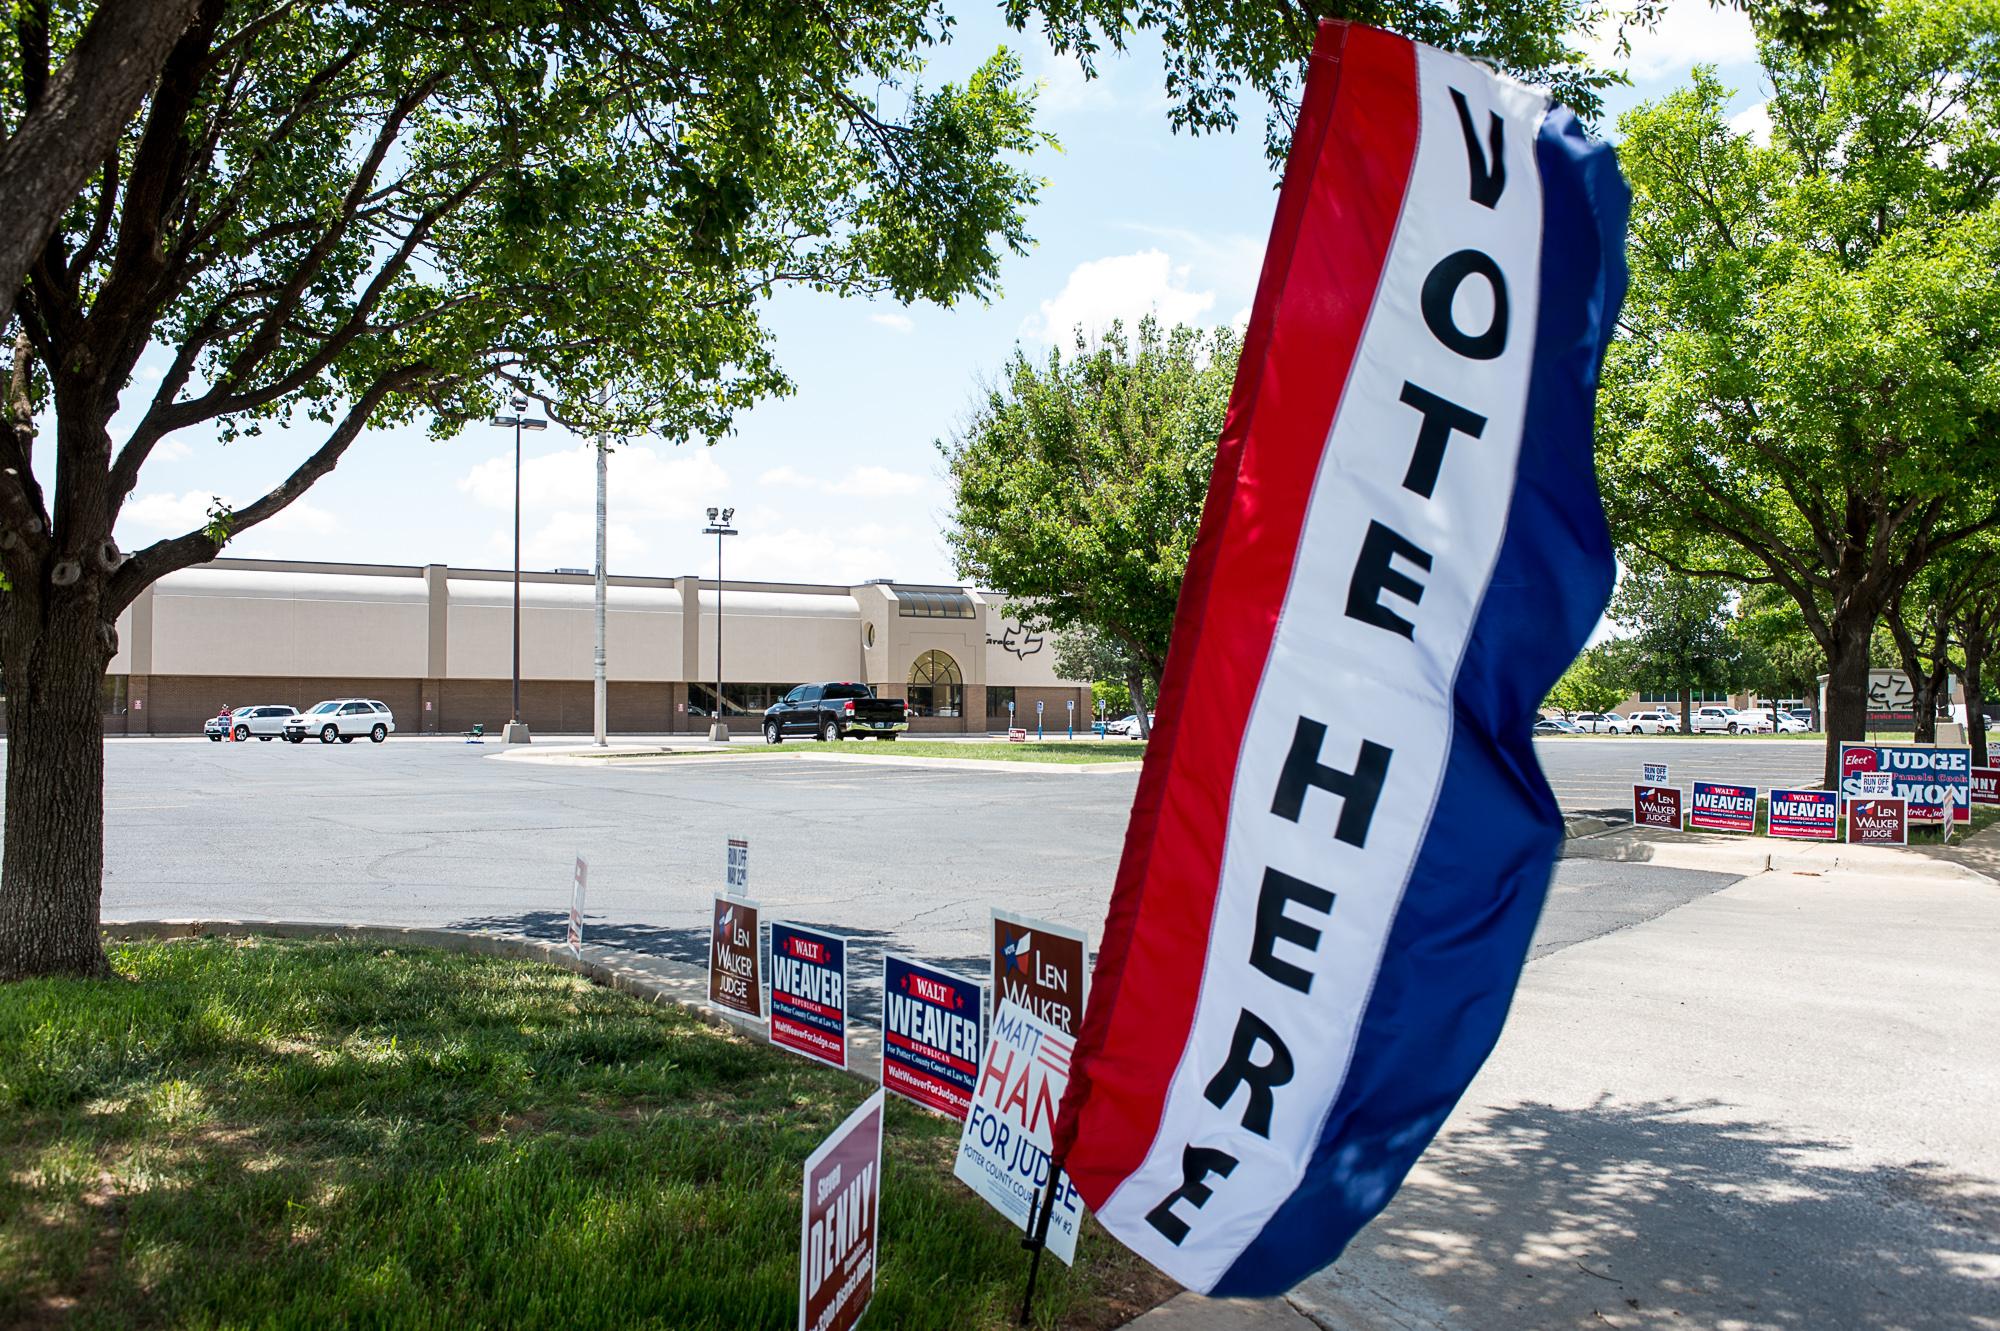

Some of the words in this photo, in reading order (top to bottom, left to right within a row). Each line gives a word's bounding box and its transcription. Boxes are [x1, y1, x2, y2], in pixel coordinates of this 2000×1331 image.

[1344, 86, 1510, 643] VOTE
[1845, 755, 1867, 765] Elect
[1880, 749, 1966, 770] JUDGE
[1644, 766, 1656, 774] RUN
[1656, 767, 1666, 775] OFF
[1644, 774, 1655, 782] MAY
[1892, 772, 1934, 782] Pamela
[1938, 774, 1968, 782] Cook
[1714, 787, 1735, 795] WALT
[1843, 779, 1968, 805] SMON
[1878, 778, 1889, 786] OFF
[1972, 778, 1997, 790] NNY
[1640, 801, 1676, 815] WALKER
[1658, 793, 1674, 804] LEN
[1695, 793, 1753, 812] WEAVER
[1646, 813, 1671, 822] JUDGE
[1772, 801, 1834, 818] WEAVER
[1878, 805, 1896, 817] LEN
[1856, 816, 1898, 829] WALKER
[1862, 829, 1892, 838] JUDGE
[734, 918, 750, 948] LEN
[717, 941, 752, 978] WALKER
[795, 939, 819, 960] WALT
[773, 954, 842, 1010] WEAVER
[1036, 950, 1067, 994] LEN
[1145, 715, 1394, 1247] HERE
[720, 976, 748, 999] JUDGE
[917, 978, 947, 1003] WALT
[792, 997, 822, 1013] REPUBLICAN
[774, 1020, 840, 1052] WaltWeaverForJudge.com
[888, 991, 977, 1064] WEAVER
[996, 1010, 1043, 1057] MATT
[887, 1043, 895, 1054] For
[895, 1046, 911, 1061] Potter
[911, 1053, 930, 1070] County
[930, 1060, 946, 1075] Court
[946, 1066, 952, 1077] at
[952, 1069, 963, 1082] Law
[911, 1041, 950, 1063] REPUBLICAN
[969, 1104, 1010, 1161] FOR
[964, 1143, 985, 1168] POTTER
[985, 1160, 1013, 1191] COUNTY
[1013, 1182, 1034, 1203] COUR
[1050, 1210, 1063, 1227] AW
[1063, 1219, 1073, 1236] #2
[809, 1161, 873, 1301] DENNY
